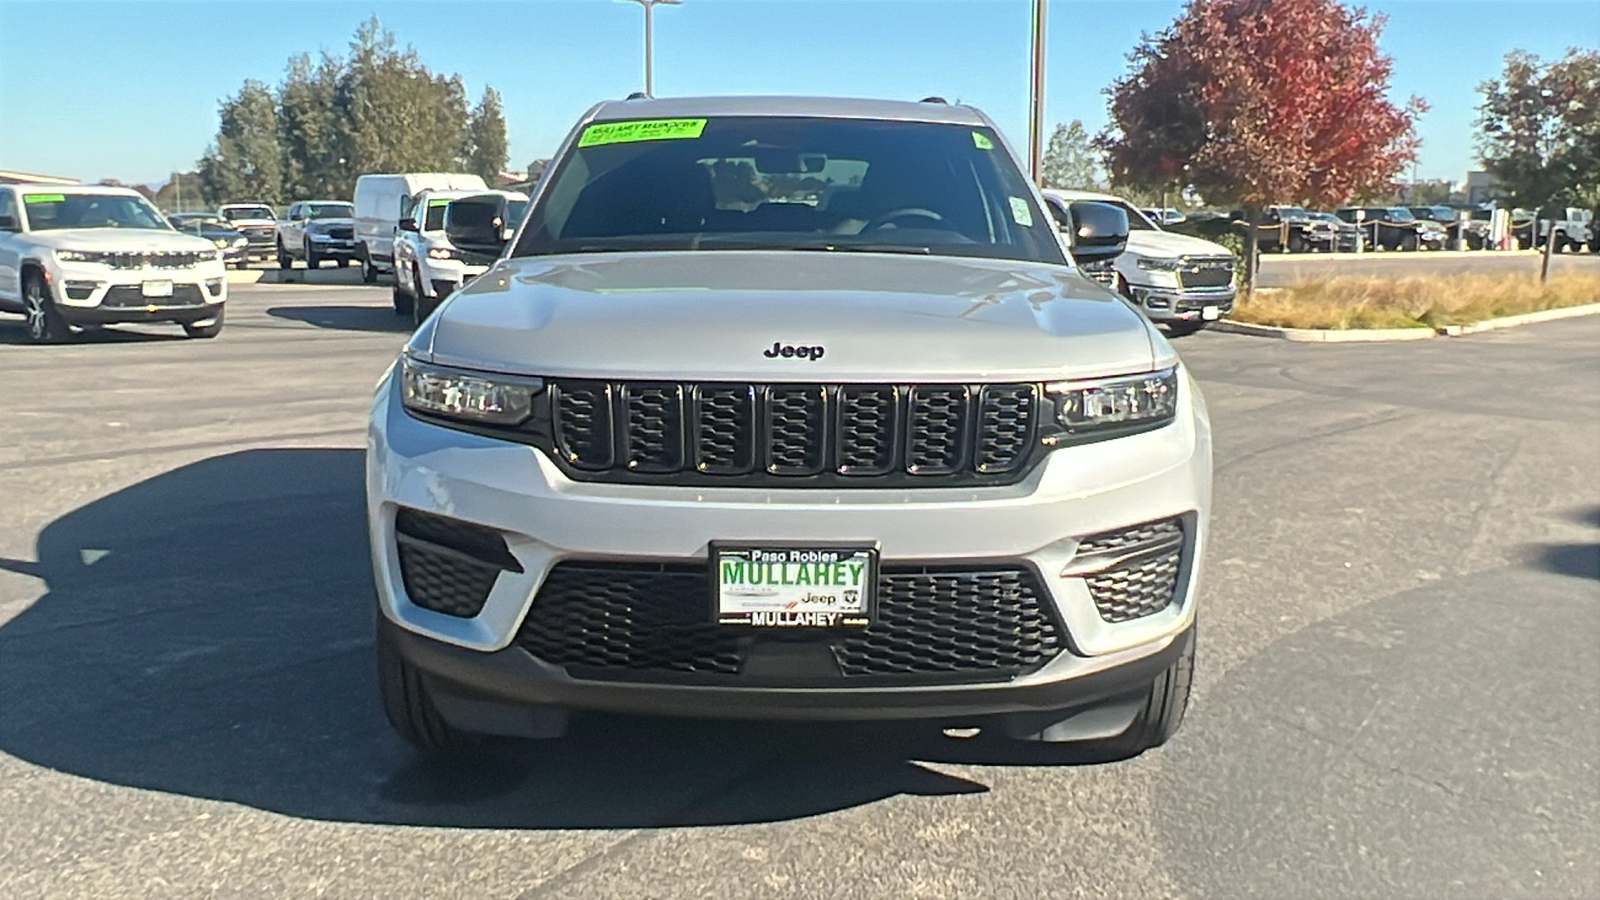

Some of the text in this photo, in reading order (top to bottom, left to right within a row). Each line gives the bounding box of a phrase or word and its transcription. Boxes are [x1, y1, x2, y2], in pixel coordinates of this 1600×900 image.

[763, 342, 825, 361] Jeep
[752, 550, 838, 563] Paso Robles
[723, 562, 864, 586] MULLAHEY
[801, 592, 837, 606] Jeep
[752, 611, 837, 626] MULLAHEY
